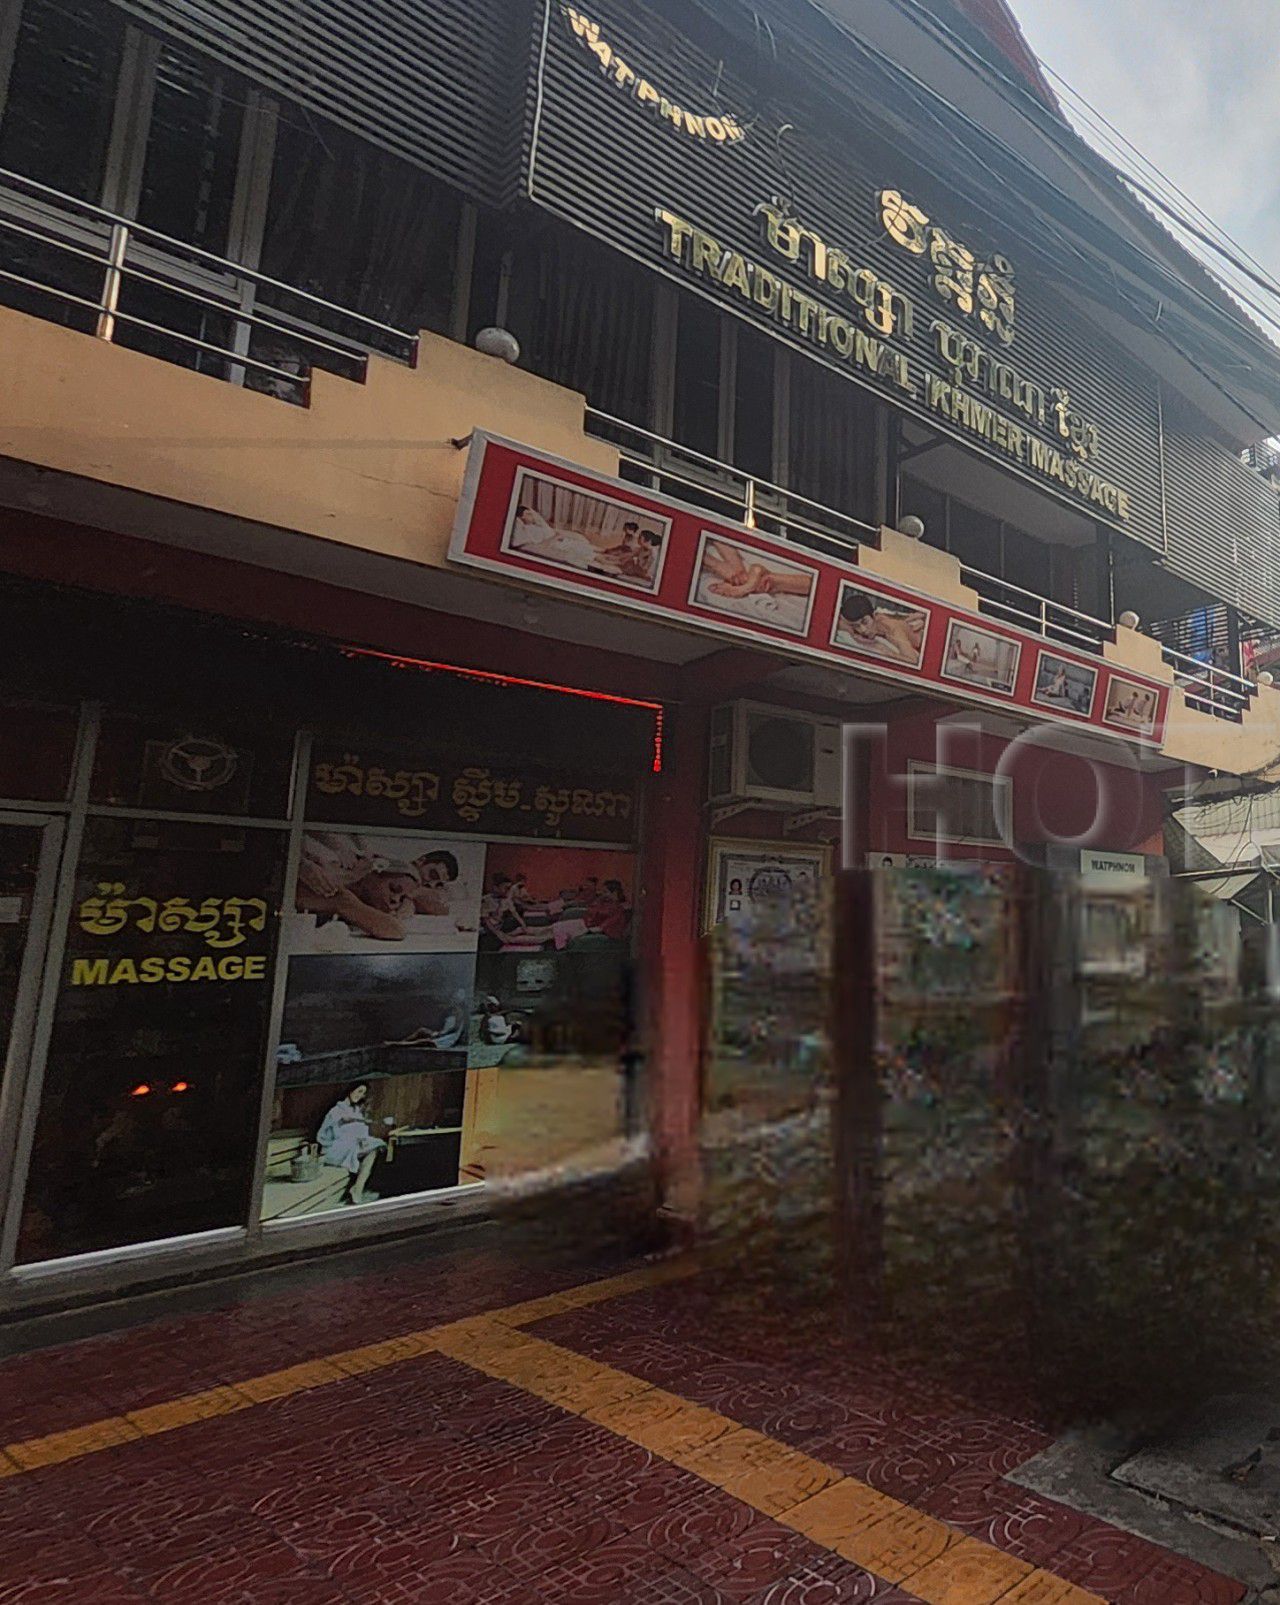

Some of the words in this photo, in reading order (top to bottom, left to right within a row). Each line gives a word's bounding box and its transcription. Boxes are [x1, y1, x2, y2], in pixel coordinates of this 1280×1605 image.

[567, 7, 635, 86] WAT
[655, 208, 917, 394] TRADITIONAL
[926, 373, 1025, 460] KHMER
[1027, 436, 1131, 521] MASSAGE
[79, 882, 268, 948] ម៉ាស្សា
[72, 956, 267, 985] MASSAGE
